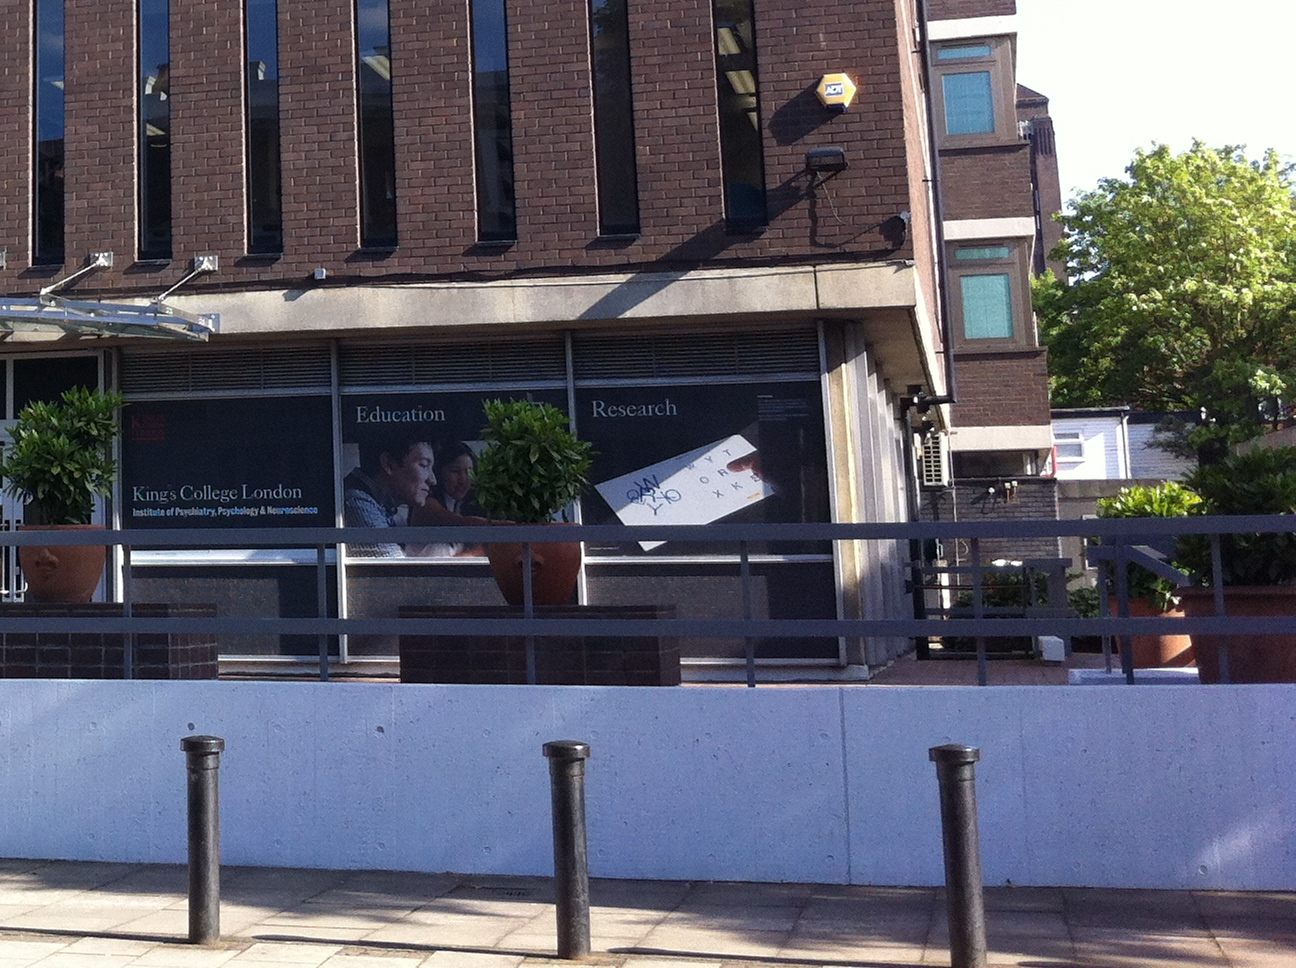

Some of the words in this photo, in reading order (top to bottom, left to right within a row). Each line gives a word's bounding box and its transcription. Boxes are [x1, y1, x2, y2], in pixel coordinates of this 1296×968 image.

[355, 405, 446, 423] Education
[591, 398, 678, 418] Research
[132, 485, 176, 503] King's
[180, 484, 238, 503] College
[242, 484, 302, 499] London
[132, 507, 165, 517] Institute
[166, 507, 175, 516] of
[175, 506, 217, 518] Psychiatry,
[217, 506, 259, 517] Psychology
[260, 506, 267, 515] &
[267, 505, 319, 515] Neuroscience
